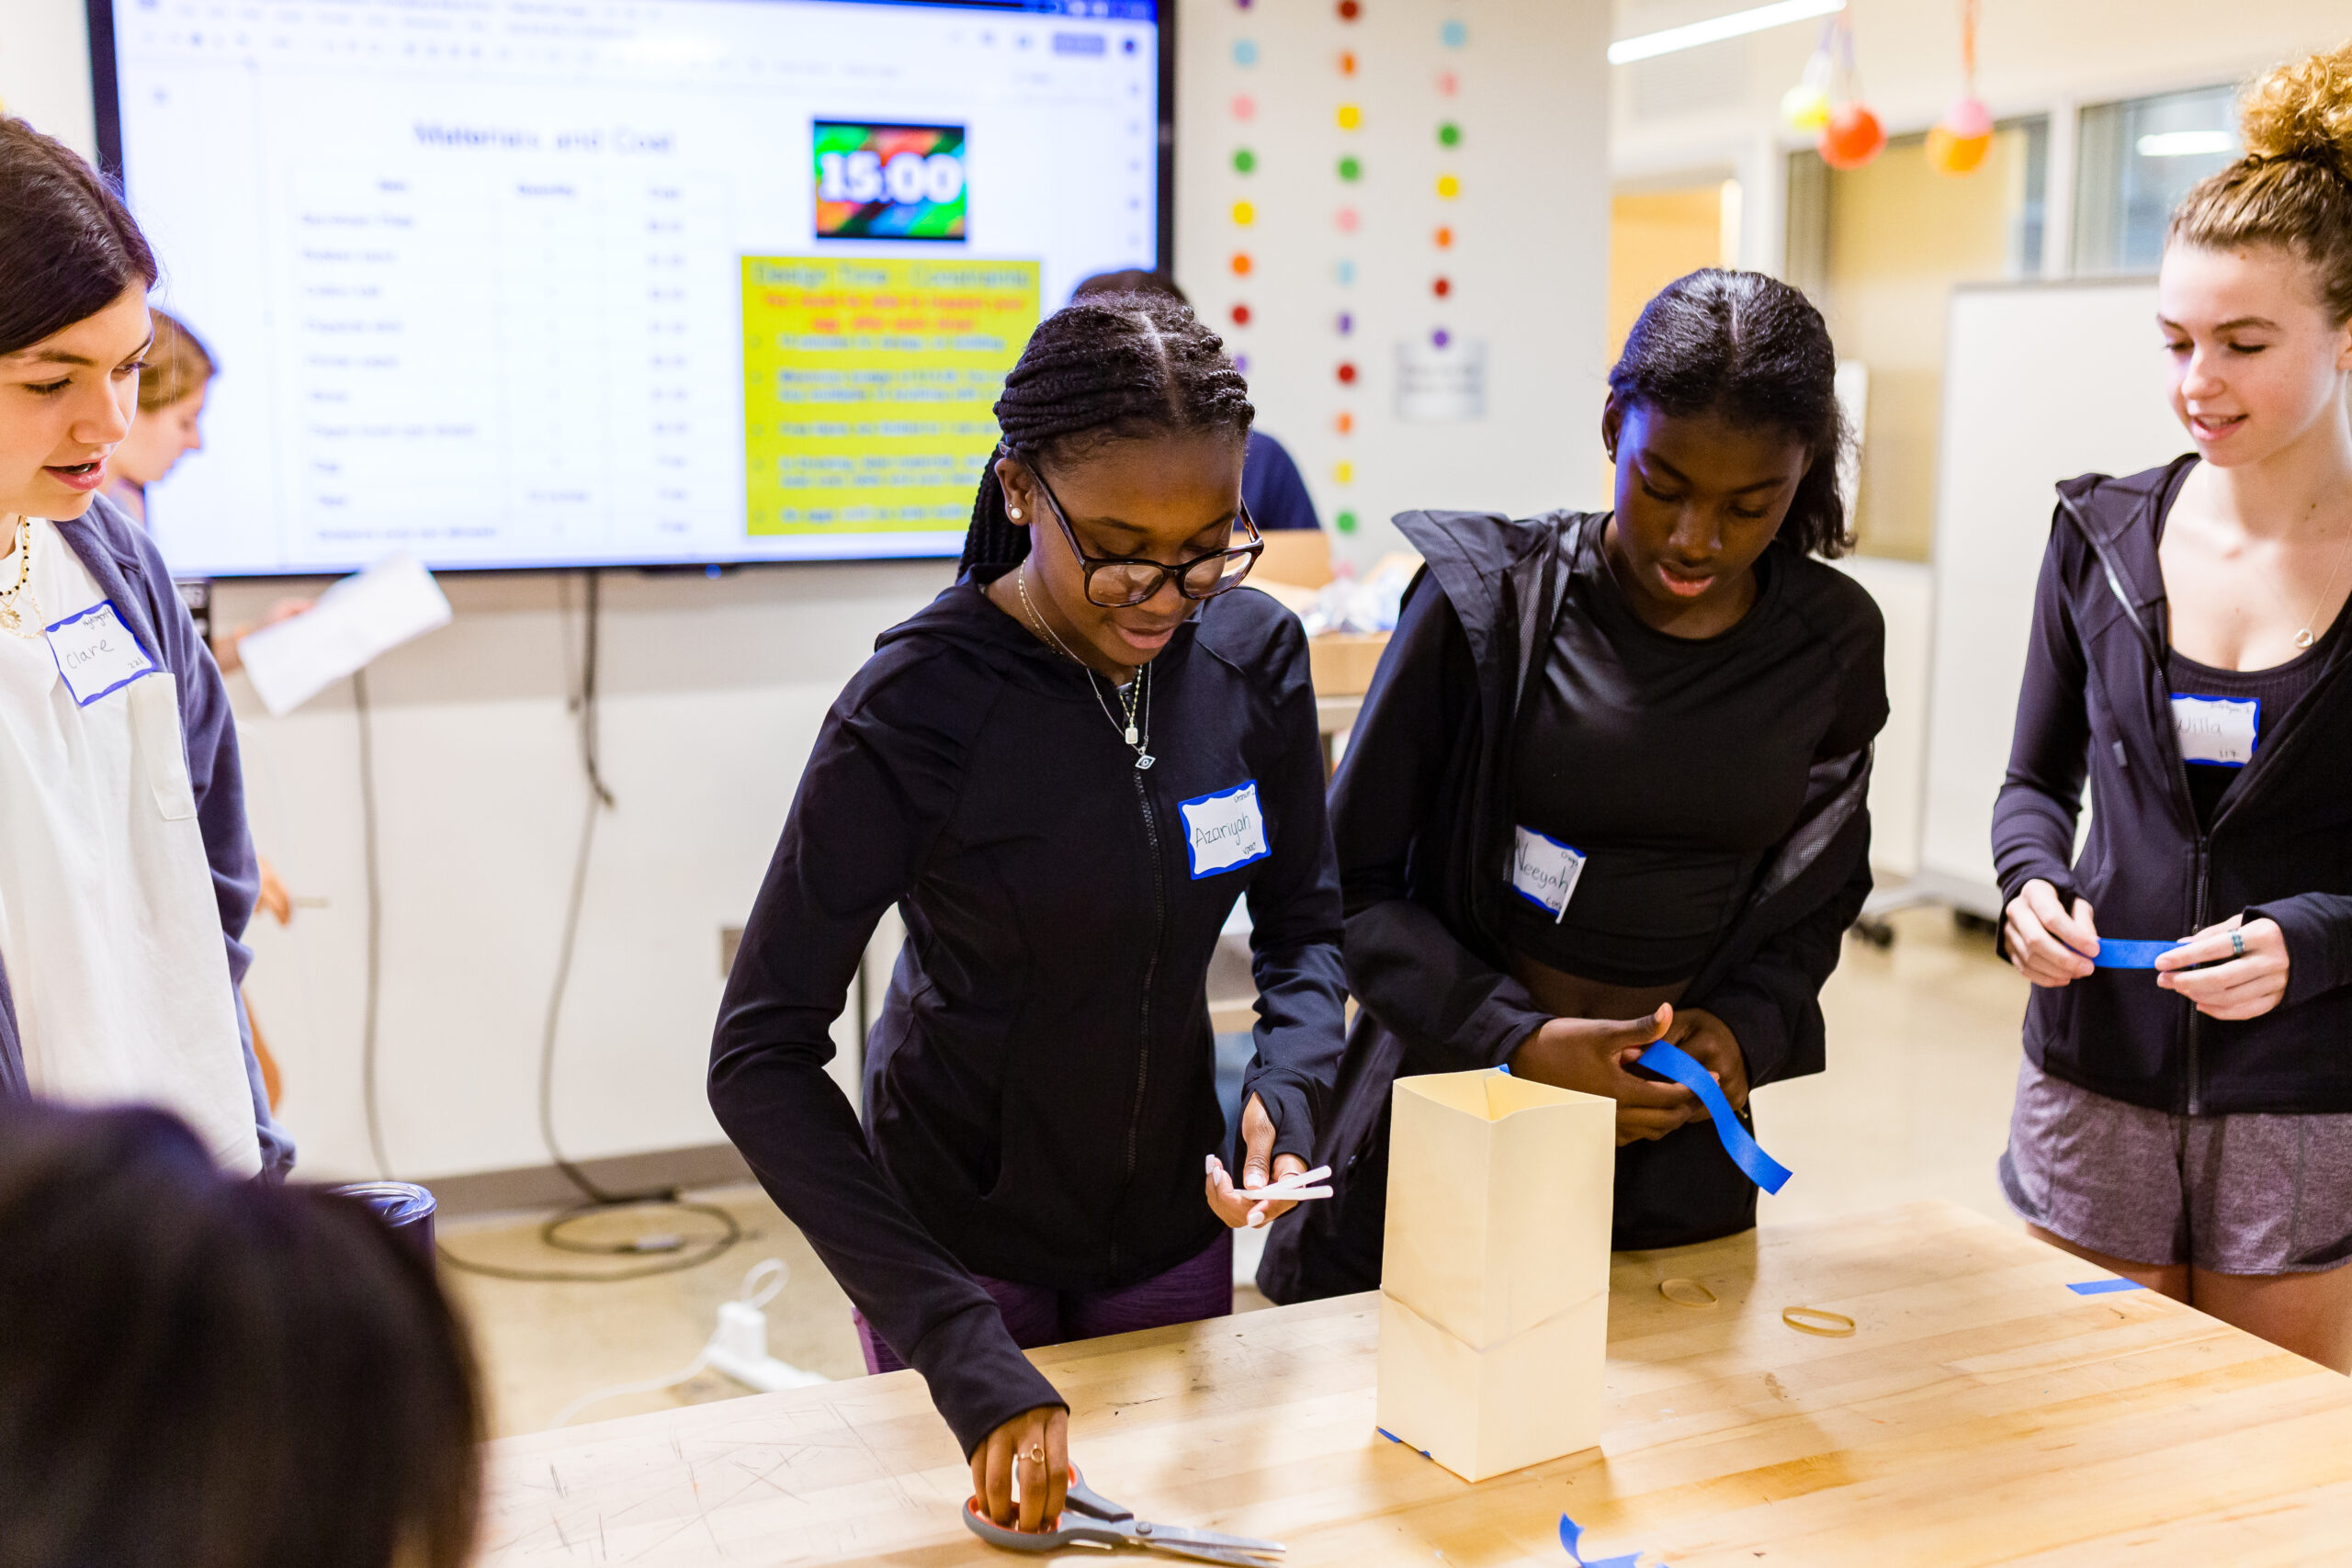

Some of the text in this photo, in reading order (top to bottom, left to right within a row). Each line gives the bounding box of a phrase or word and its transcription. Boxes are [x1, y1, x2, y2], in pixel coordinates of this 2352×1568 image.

[819, 151, 964, 205] 15:00
[66, 639, 115, 670] Clare
[1195, 812, 1251, 848] Azariyah
